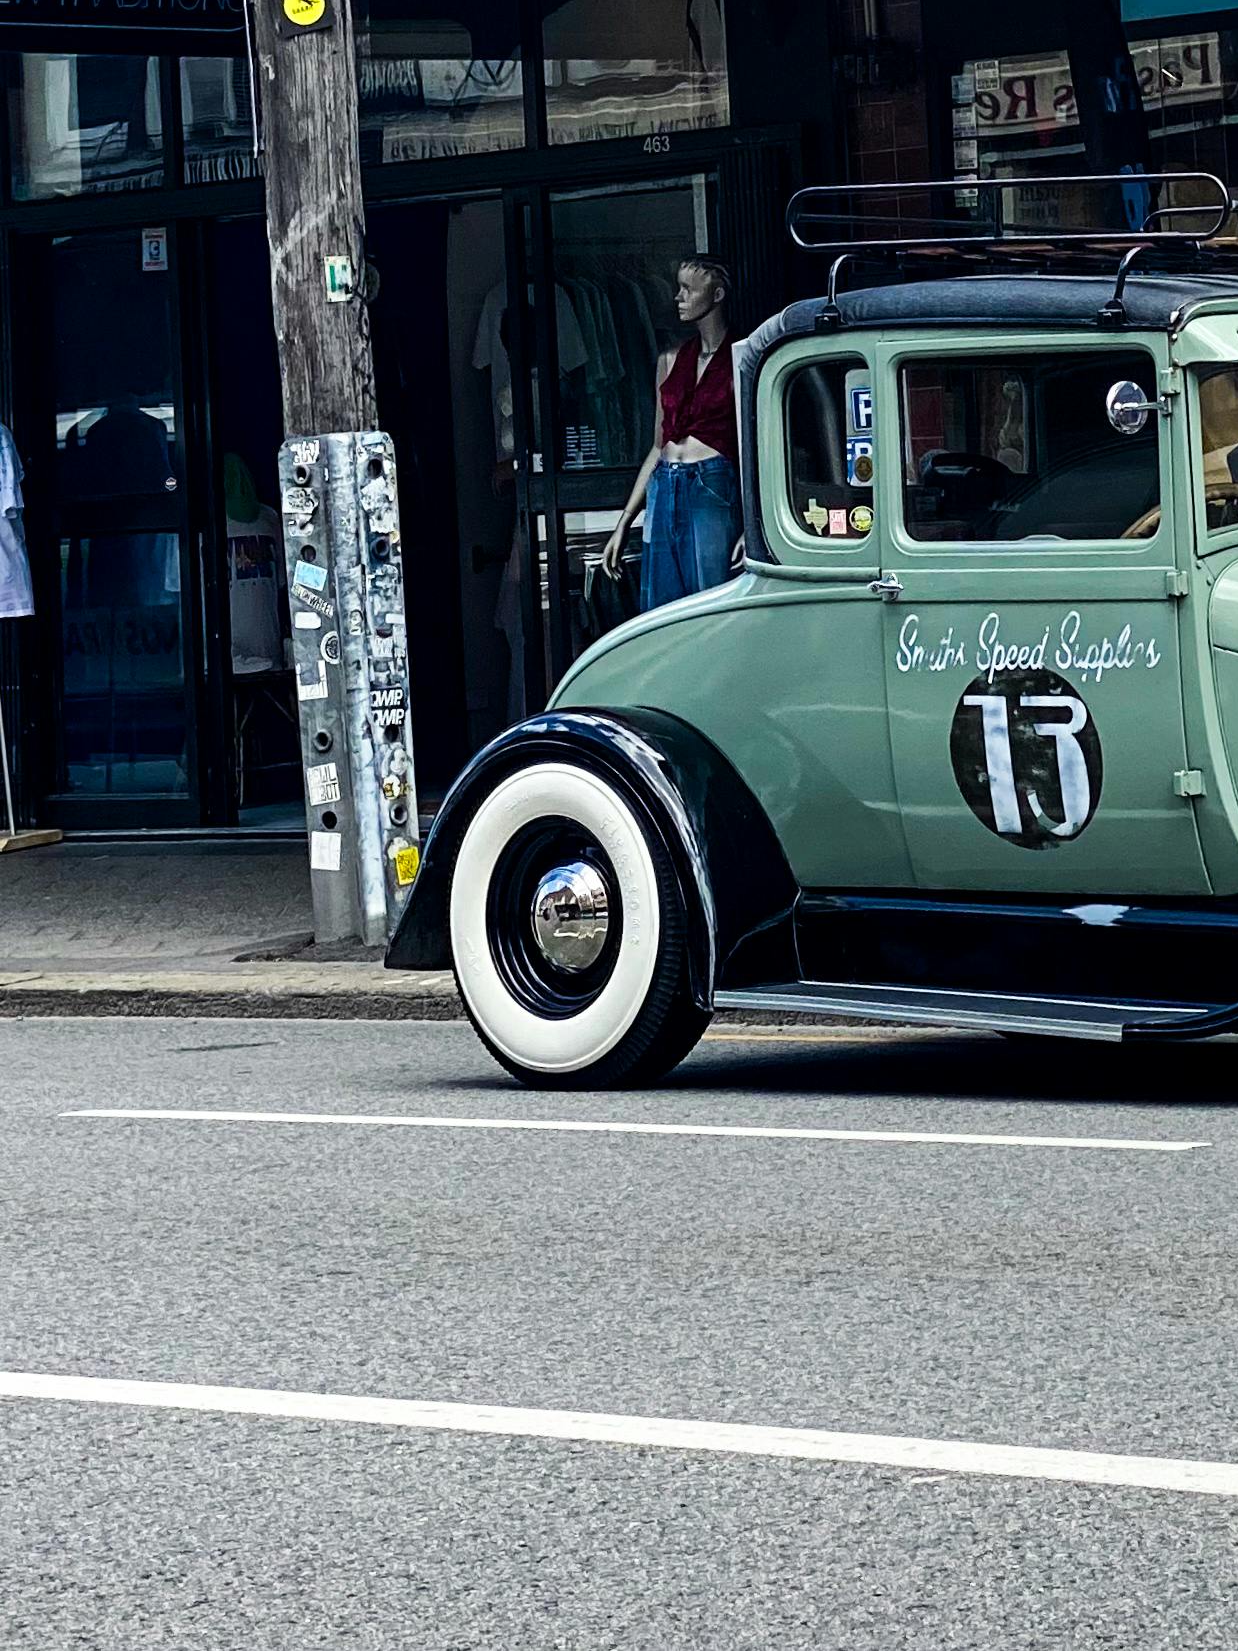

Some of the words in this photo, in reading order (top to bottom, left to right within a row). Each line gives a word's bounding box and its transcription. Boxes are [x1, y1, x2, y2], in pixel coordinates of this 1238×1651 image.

[643, 136, 670, 153] 463
[976, 612, 1050, 684] Speed
[963, 695, 1090, 837] 13
